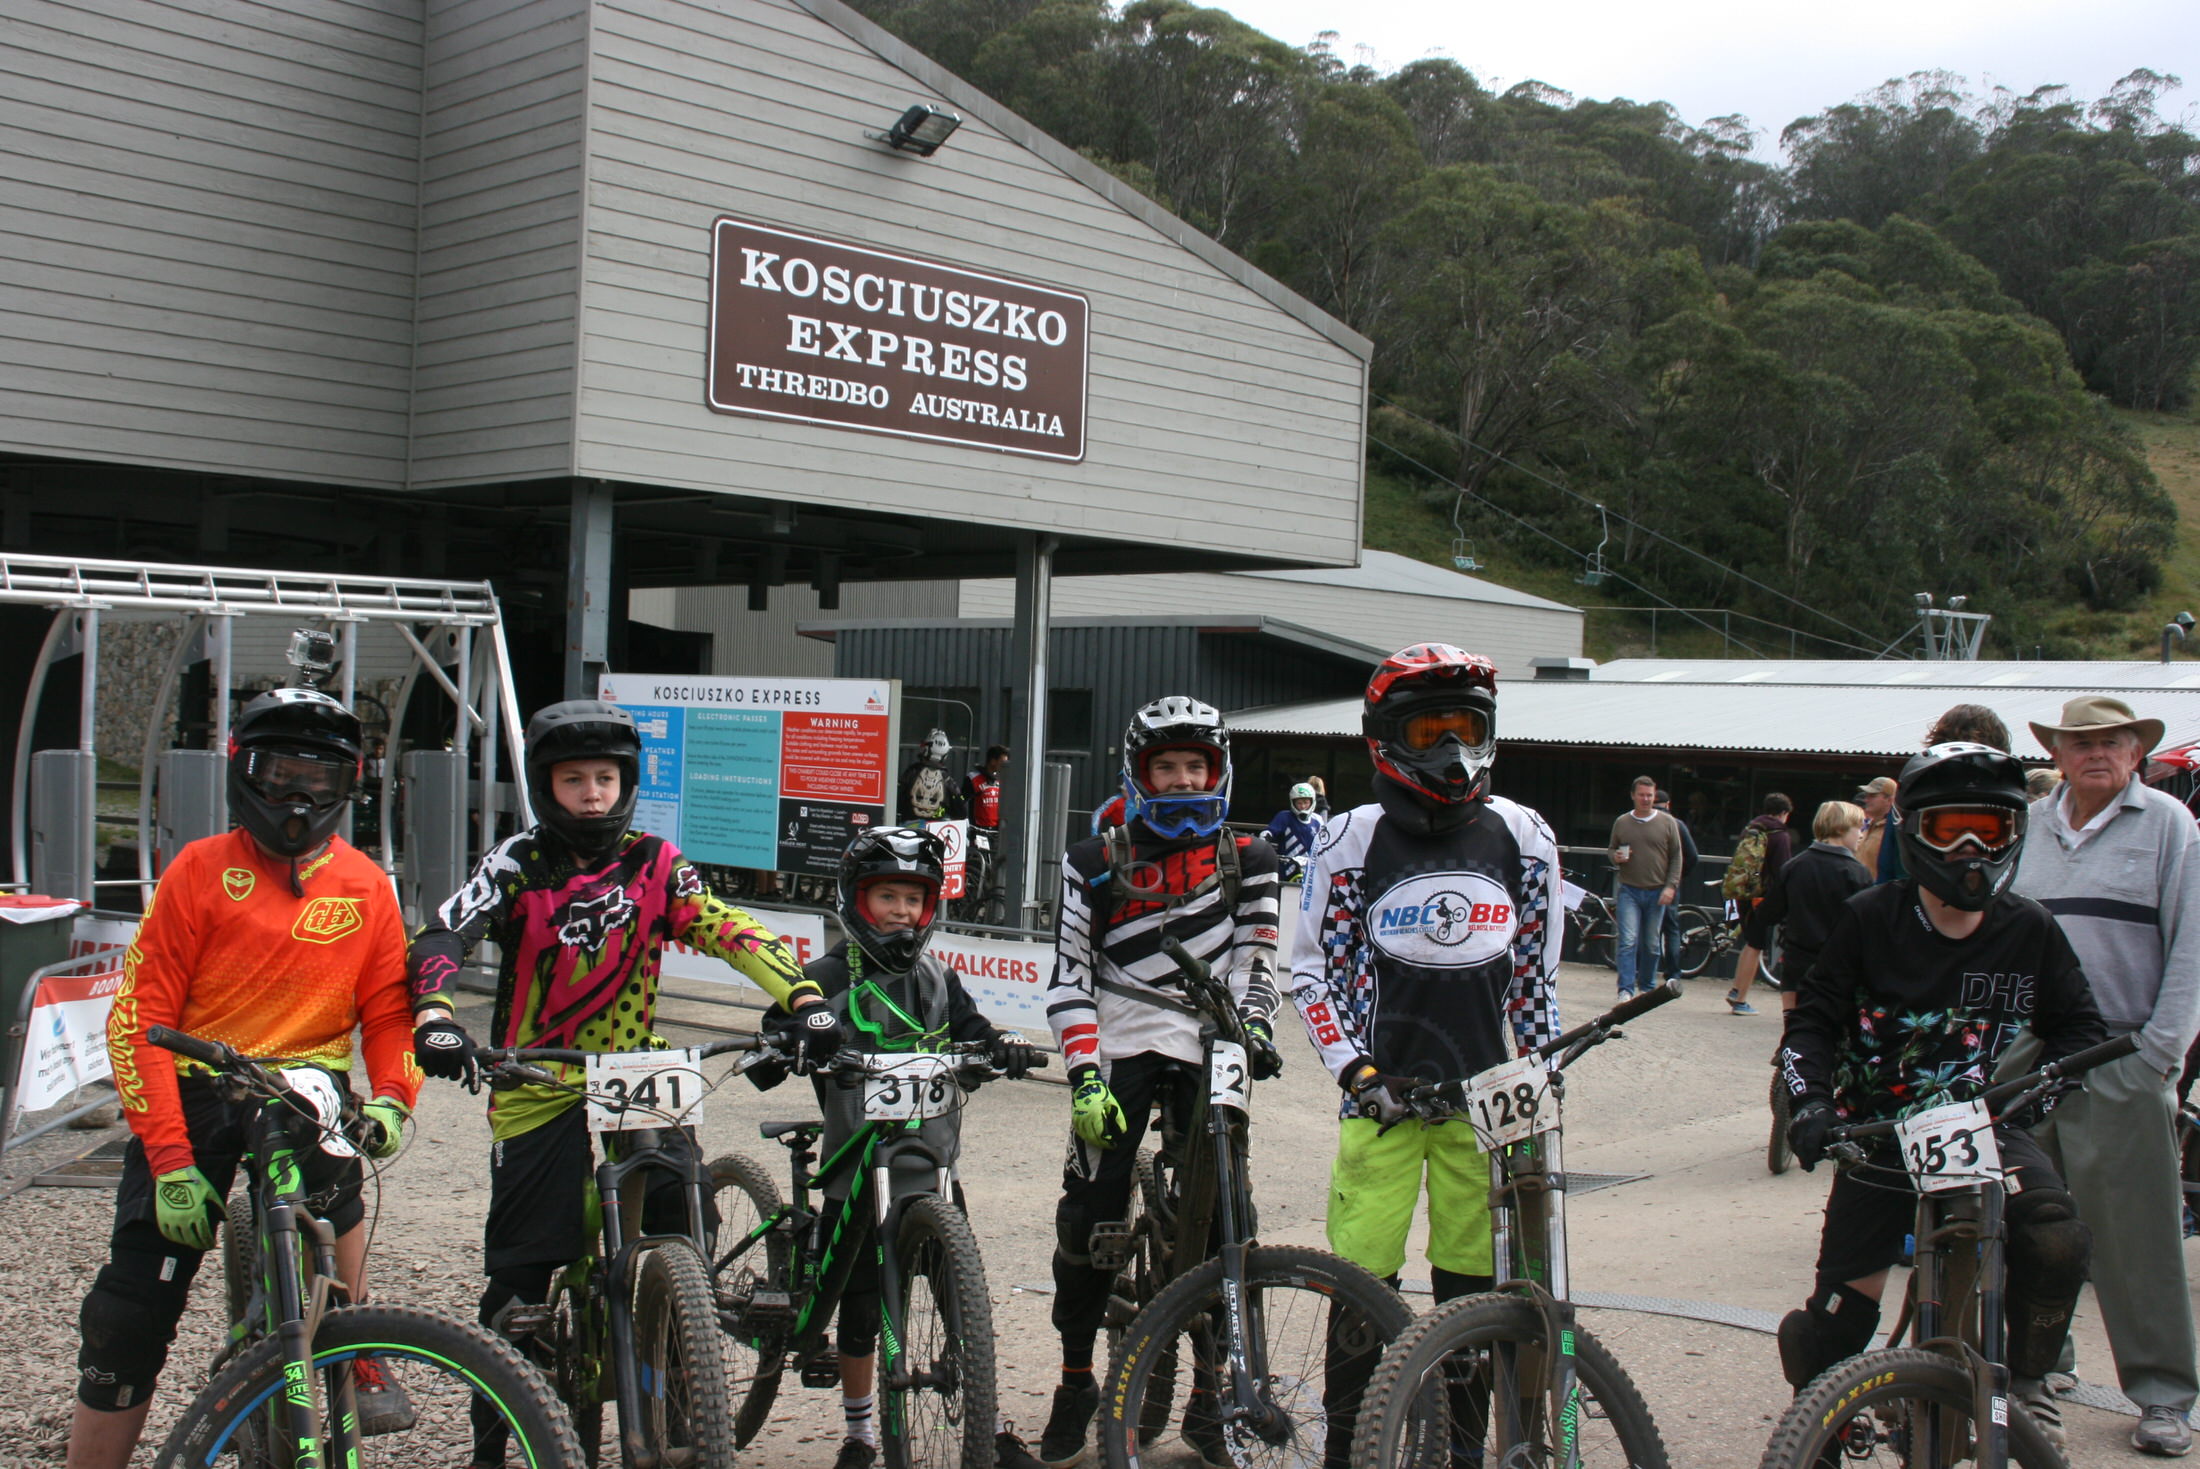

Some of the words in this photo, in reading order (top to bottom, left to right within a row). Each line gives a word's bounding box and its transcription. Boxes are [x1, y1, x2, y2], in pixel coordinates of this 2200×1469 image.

[740, 247, 1067, 346] KOSCIUSZKO
[786, 314, 1028, 391] EXPRESS
[736, 363, 889, 409] THREDBO
[909, 392, 1065, 437] AUSTRALIA
[654, 686, 744, 703] KOSCIUSZKO
[752, 688, 821, 705] EXPRESS
[810, 717, 859, 729] WARNING
[1379, 905, 1440, 929] NBC
[1468, 903, 1511, 924] BB
[1305, 1001, 1341, 1047] BB
[604, 1075, 681, 1114] 341
[879, 1074, 947, 1105] 318
[1478, 1082, 1539, 1131] 128
[1910, 1128, 1979, 1180] 353
[285, 1366, 303, 1383] 34
[1822, 1371, 1896, 1430] MAXXIS
